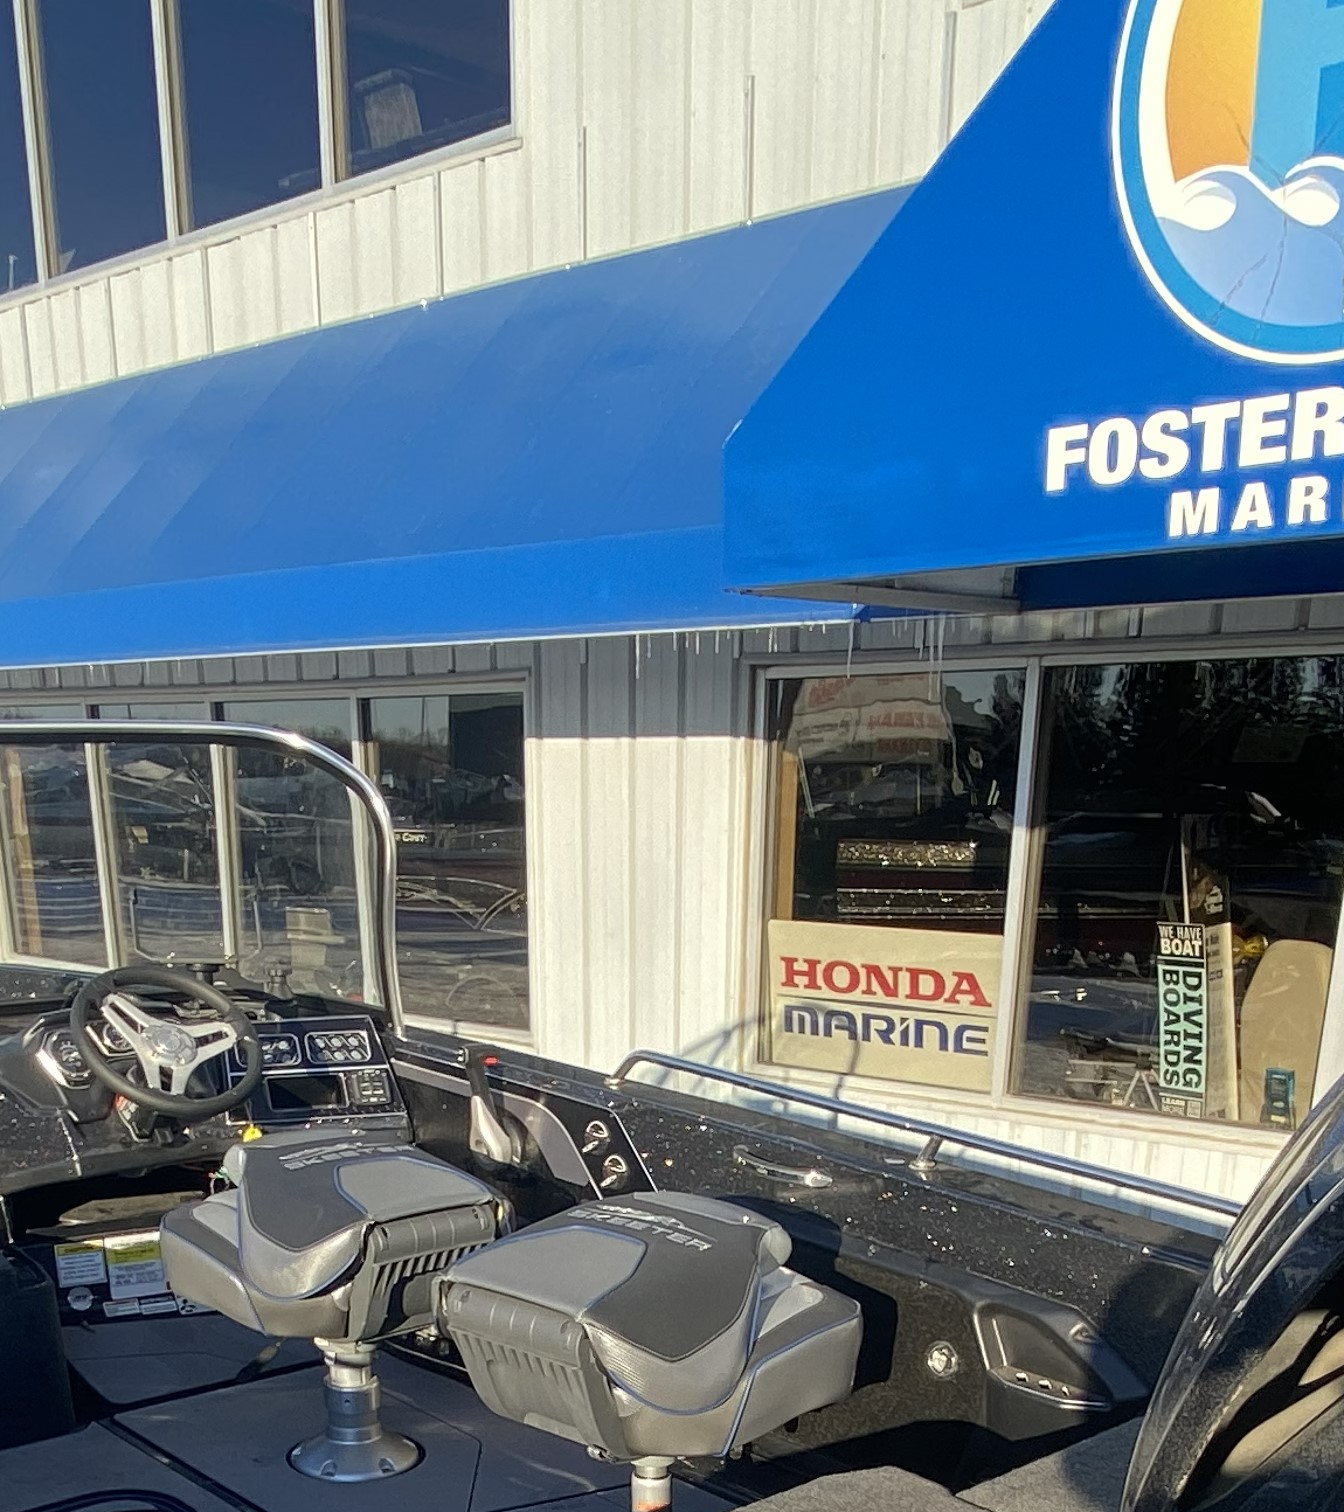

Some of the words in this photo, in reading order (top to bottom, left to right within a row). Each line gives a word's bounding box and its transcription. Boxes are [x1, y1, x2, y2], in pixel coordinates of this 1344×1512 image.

[1158, 925, 1175, 939] WE
[1176, 926, 1202, 941] HAVE
[1160, 937, 1202, 957] BOAT
[779, 955, 993, 1009] HONDA
[1162, 968, 1180, 1087] BOARDS
[1182, 970, 1203, 1089] DIVING
[567, 1209, 713, 1251] SKEETER
